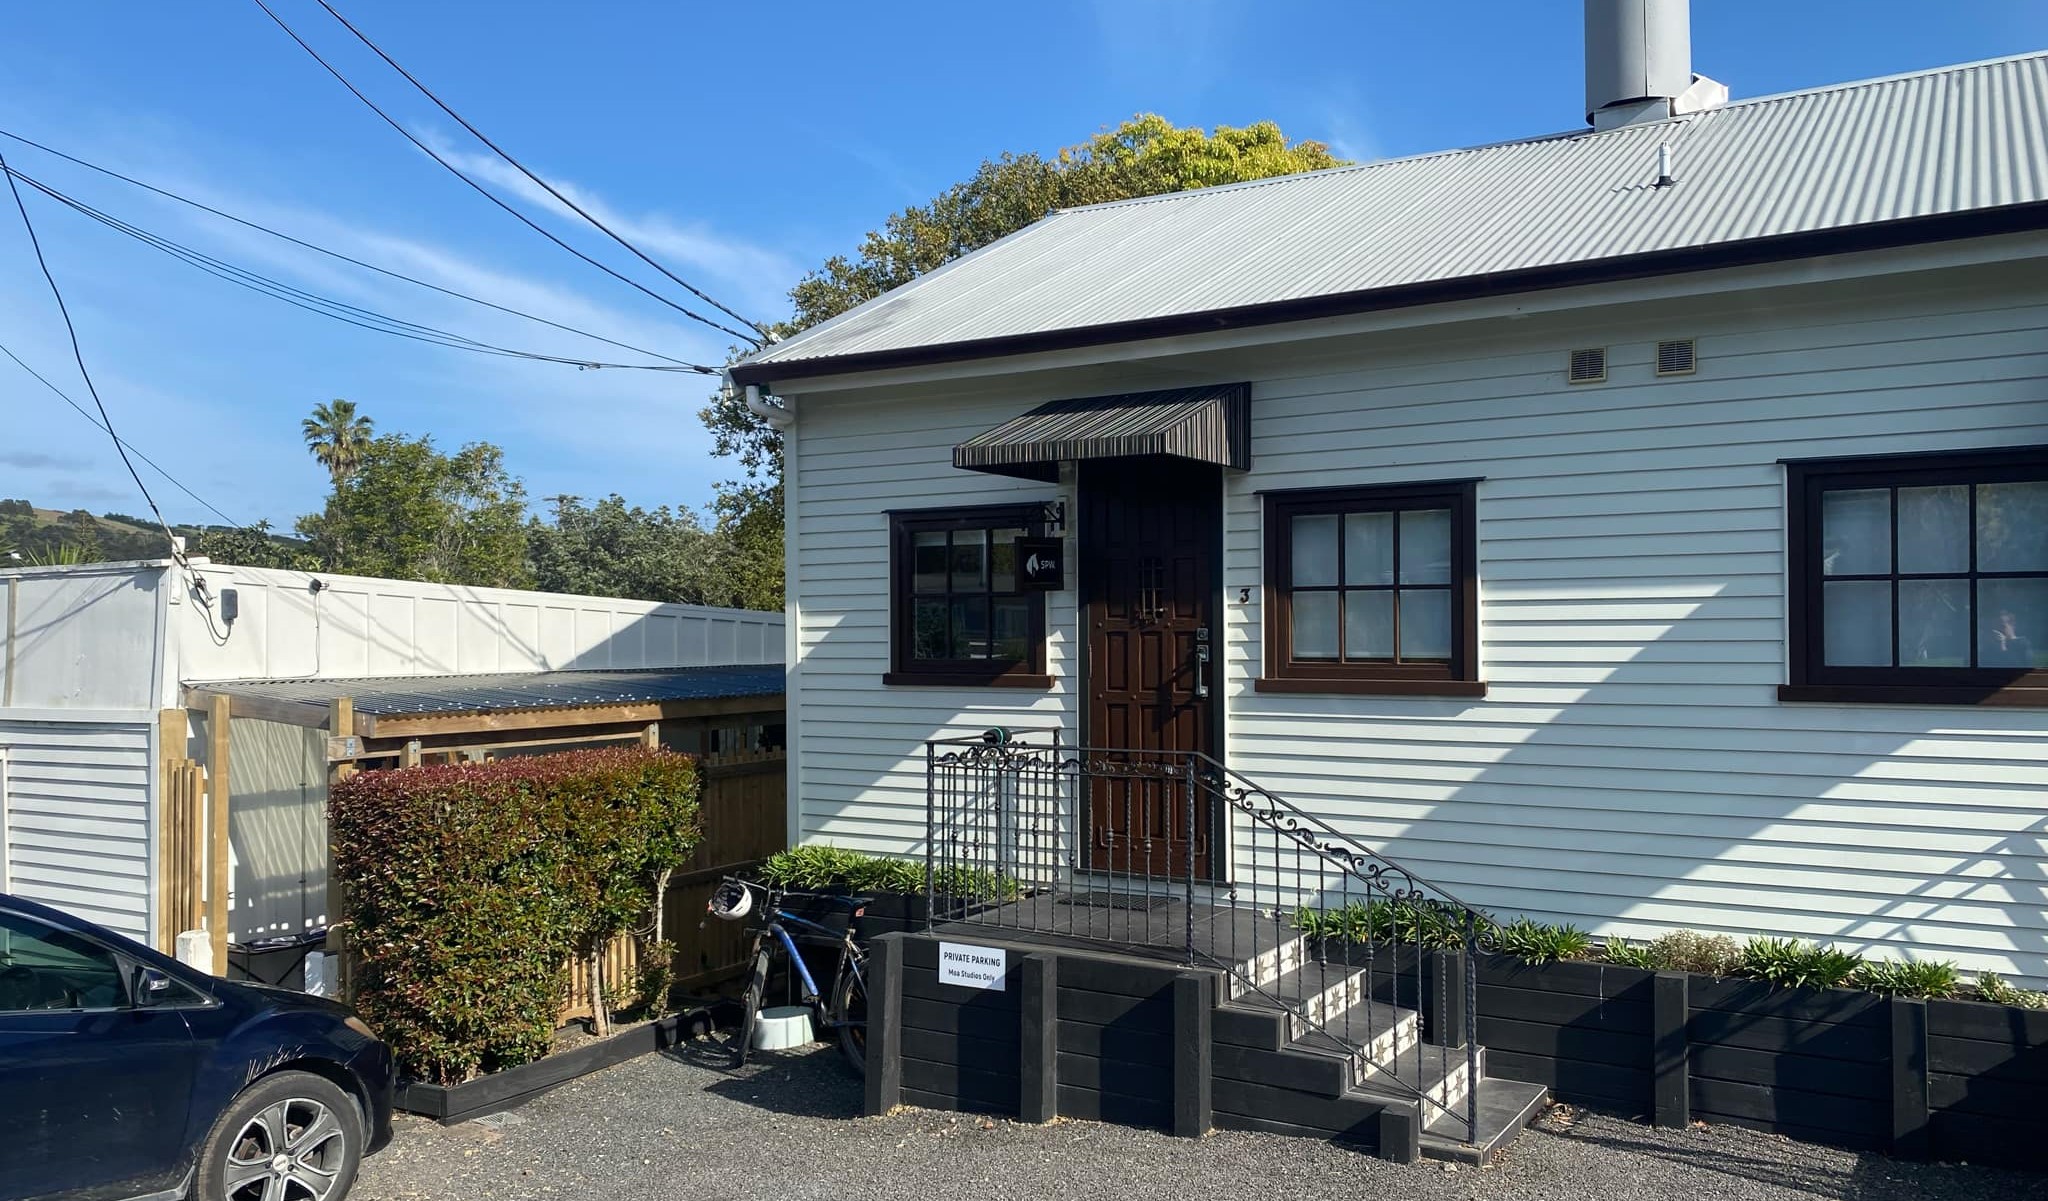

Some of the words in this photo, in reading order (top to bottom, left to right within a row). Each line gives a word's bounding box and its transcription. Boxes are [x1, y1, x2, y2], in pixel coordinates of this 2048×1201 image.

[1240, 588, 1250, 603] 3
[944, 952, 970, 963] PRIVATE
[971, 955, 1000, 967] PARKING
[961, 970, 981, 980] Studios
[983, 973, 995, 983] Only
